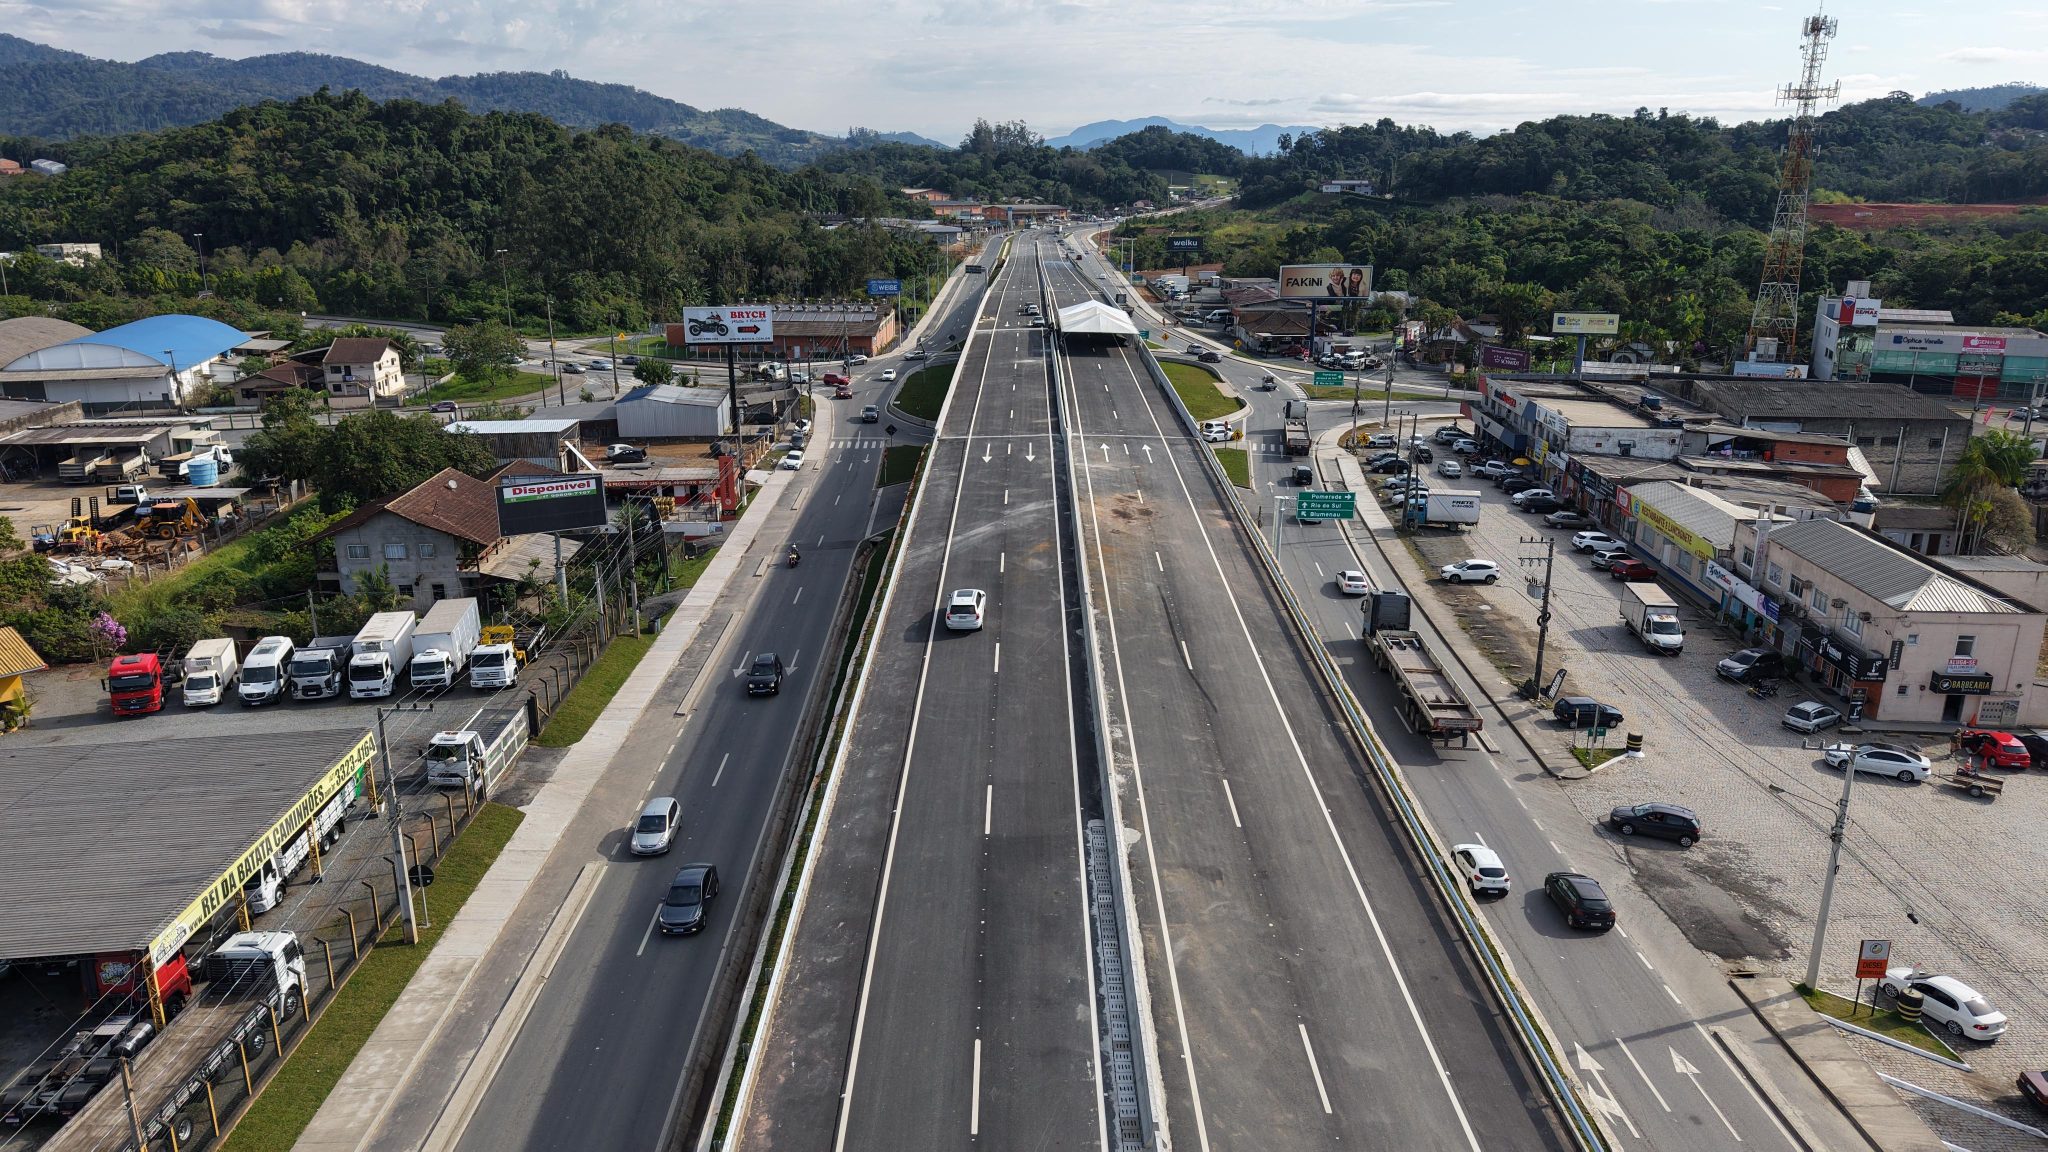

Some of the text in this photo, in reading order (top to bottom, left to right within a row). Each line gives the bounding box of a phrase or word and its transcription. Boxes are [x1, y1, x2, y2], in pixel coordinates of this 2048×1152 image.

[730, 311, 766, 319] BRYCH
[1952, 681, 1990, 689] BARBEARIA
[335, 736, 375, 786] 3323-4164
[201, 887, 220, 920] REI
[221, 872, 237, 899] DA
[237, 839, 274, 884] BATATA
[272, 784, 325, 847] CAMINHÕES
